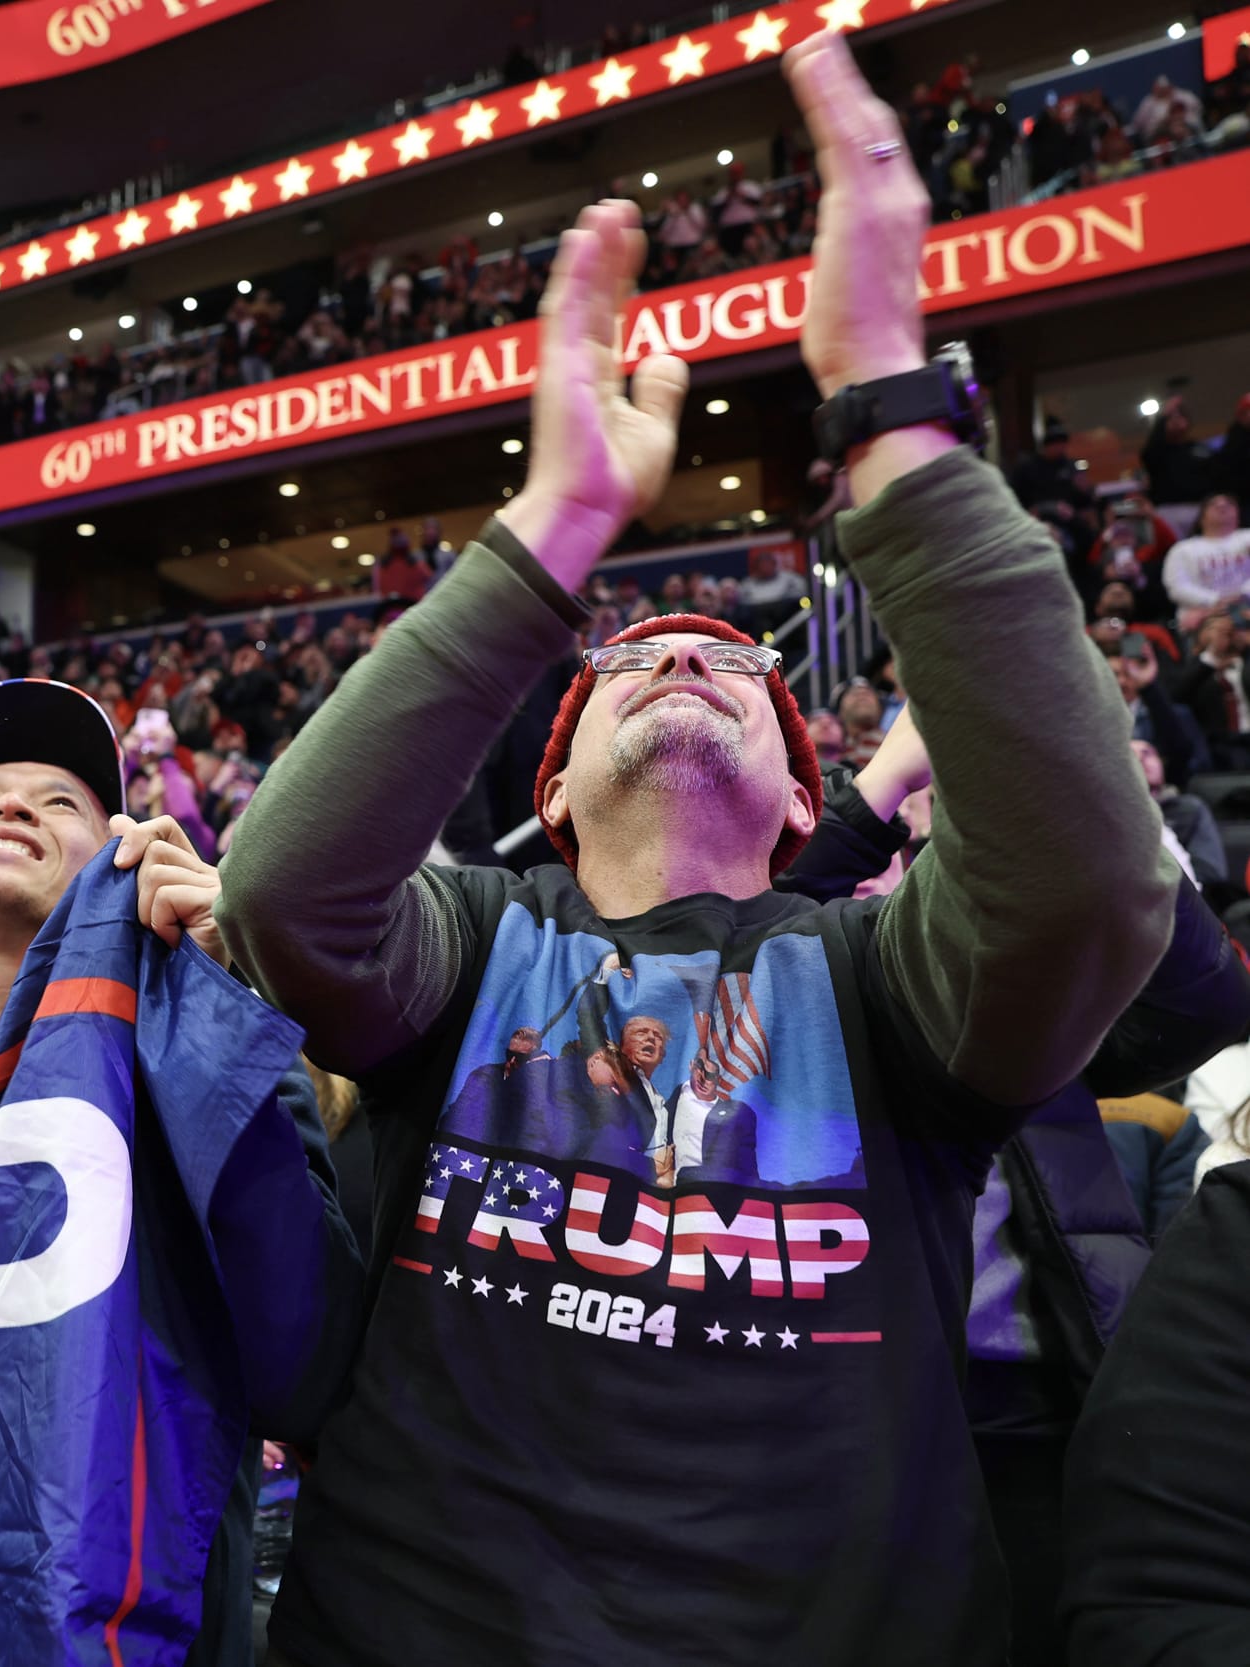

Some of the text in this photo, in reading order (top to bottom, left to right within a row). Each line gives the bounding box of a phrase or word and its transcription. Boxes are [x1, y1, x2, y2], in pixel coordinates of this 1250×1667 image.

[41, 193, 1148, 488] 60TH PRESIDENTIAL AUGUTION
[414, 1141, 871, 1300] TRUMP
[546, 1282, 677, 1349] 2024
